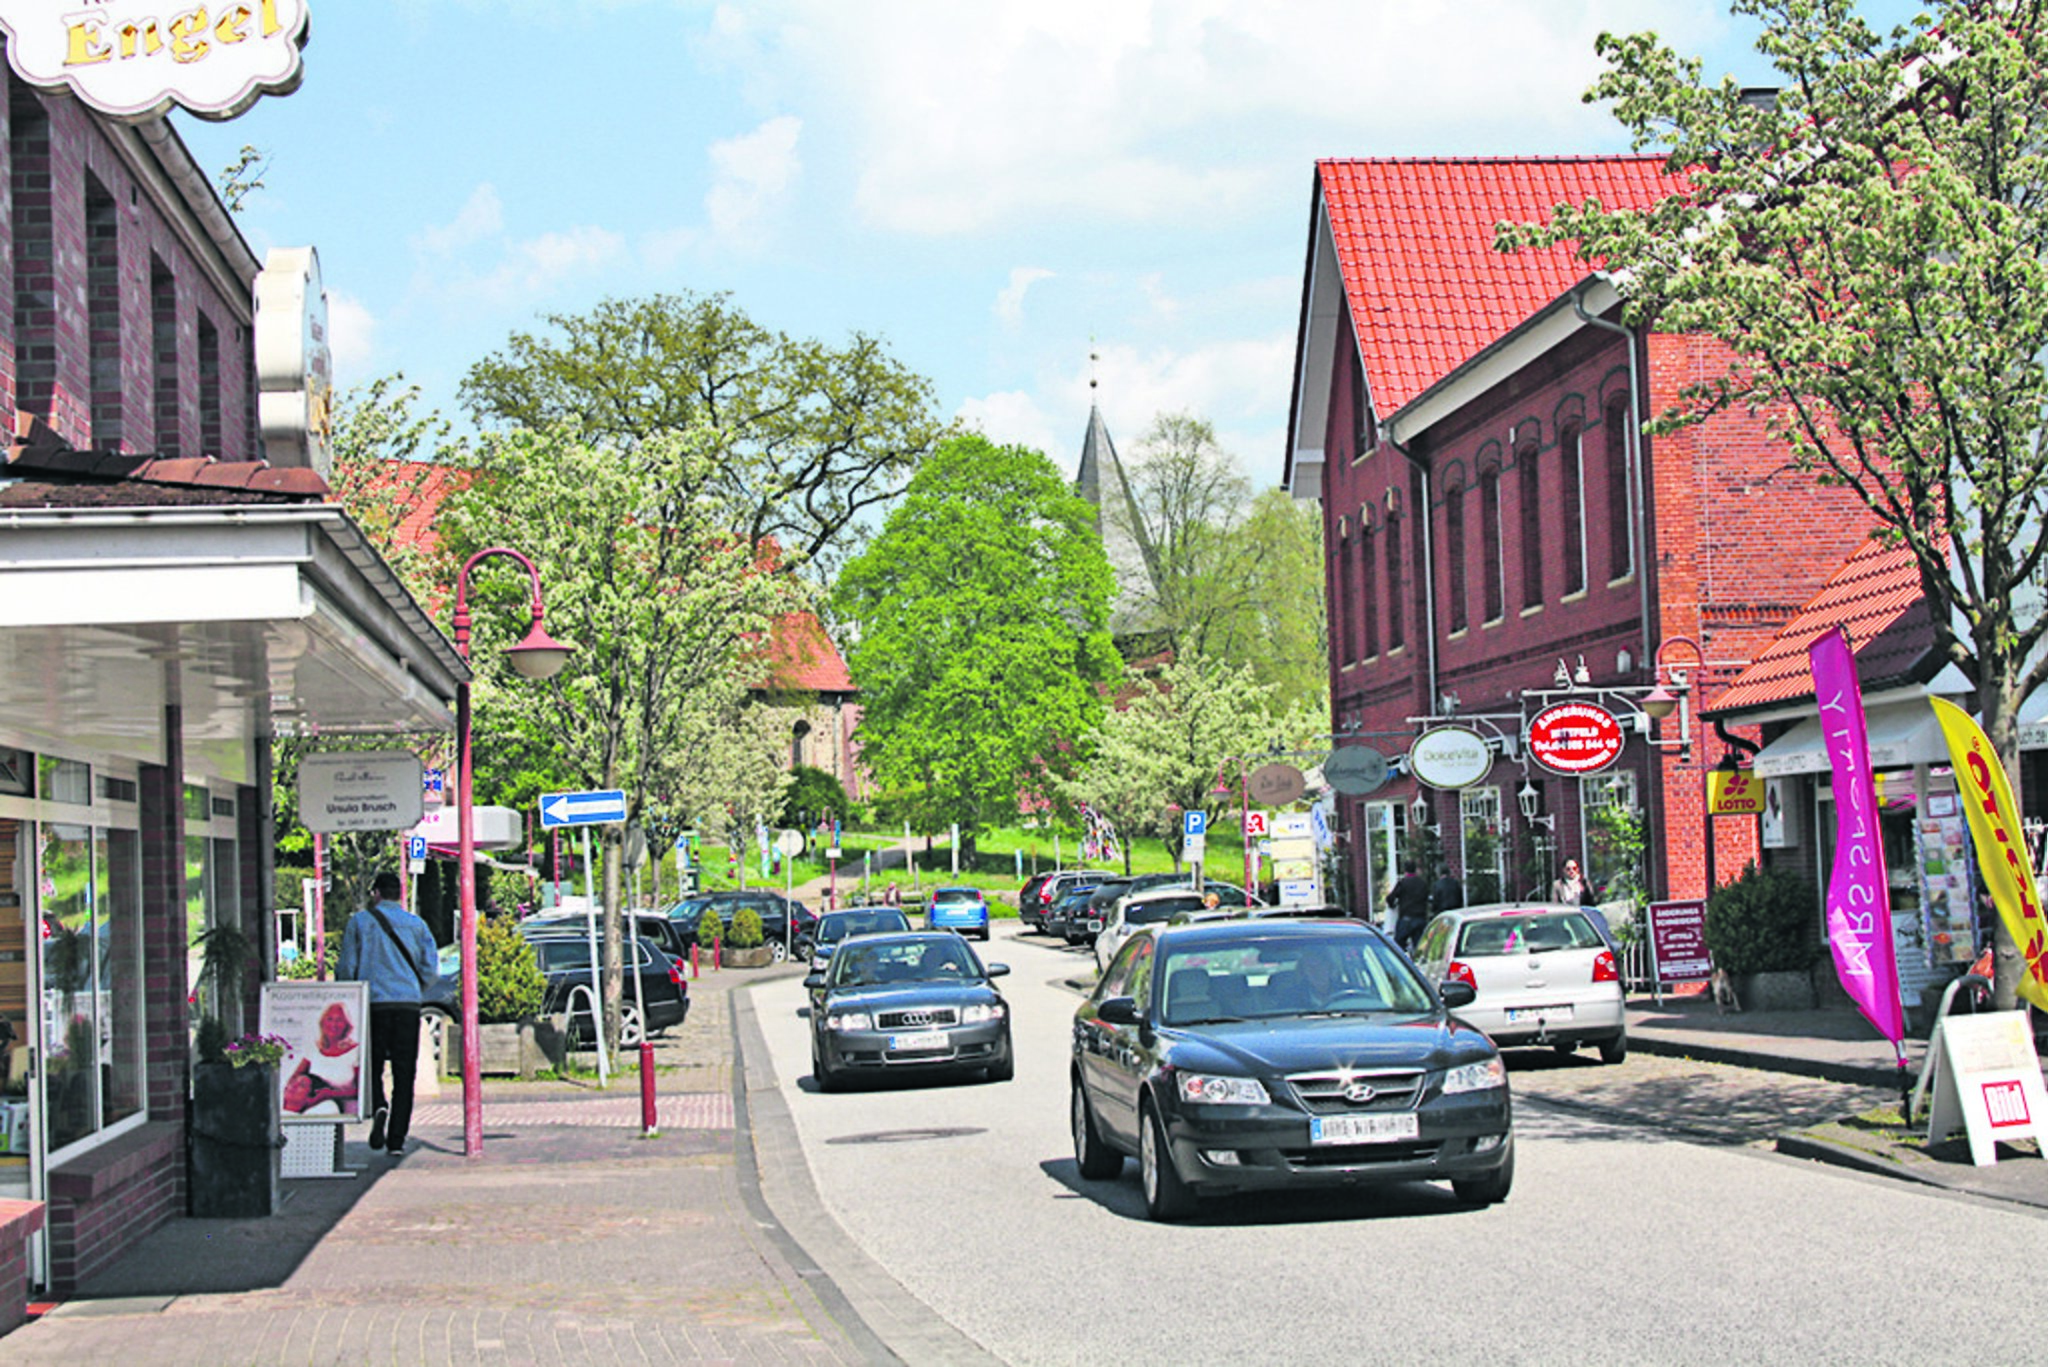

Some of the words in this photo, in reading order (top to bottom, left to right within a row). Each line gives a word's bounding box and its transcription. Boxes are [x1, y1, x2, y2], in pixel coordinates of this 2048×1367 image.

[61, 0, 283, 67] Engel
[1537, 705, 1612, 730] ÄNDERUNGS
[326, 803, 359, 814] Ursula
[361, 801, 397, 813] Brusch
[1717, 798, 1757, 811] LOTTO
[1188, 814, 1202, 832] P
[413, 839, 424, 857] P
[1985, 1083, 2028, 1124] Bild
